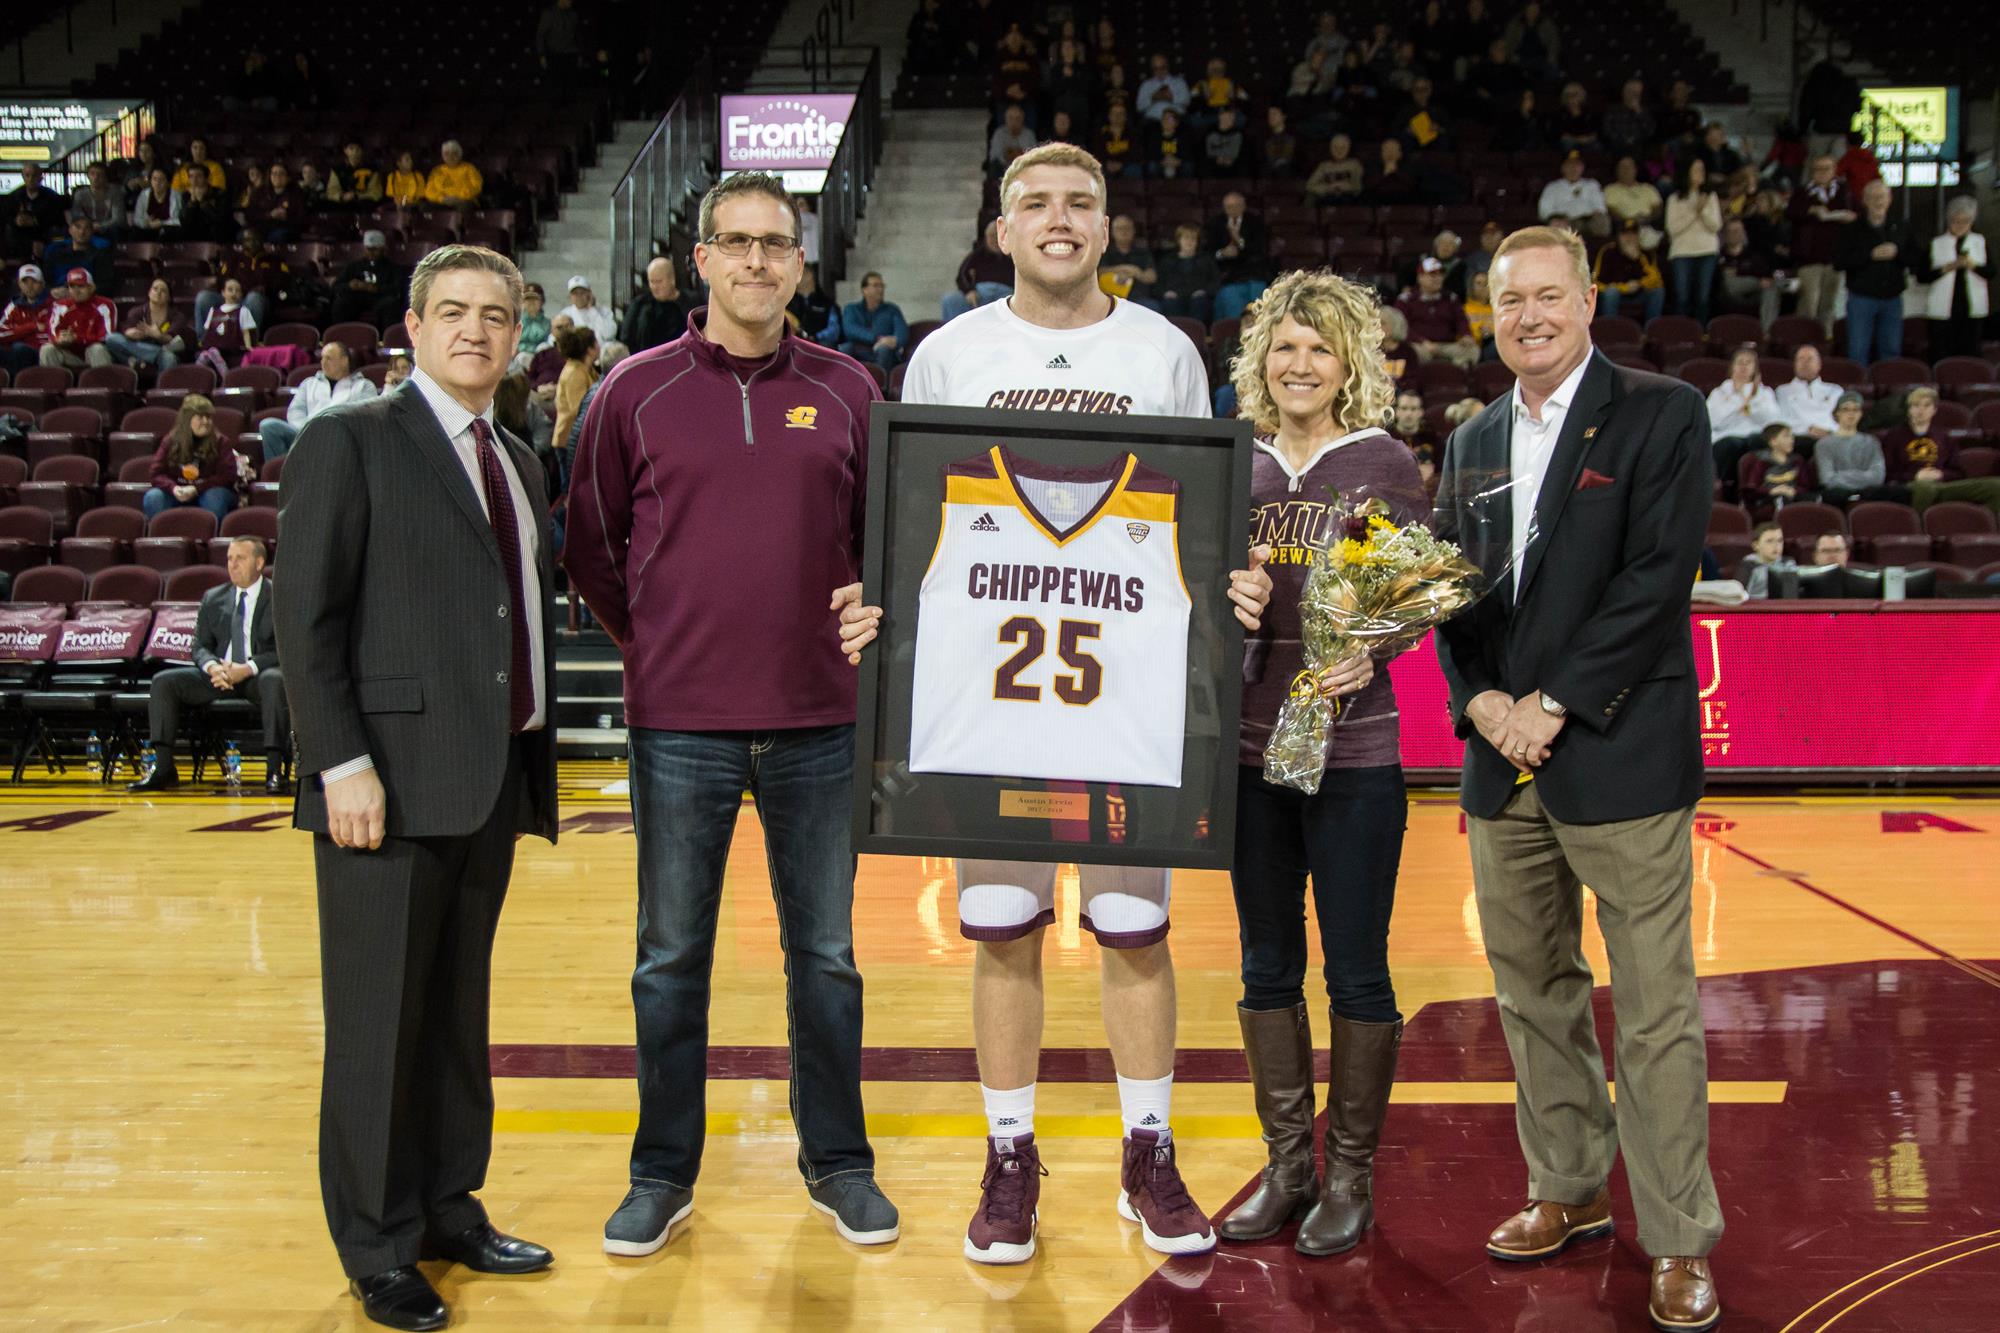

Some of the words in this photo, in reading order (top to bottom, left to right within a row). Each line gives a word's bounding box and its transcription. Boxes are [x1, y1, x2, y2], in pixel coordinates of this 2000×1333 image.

[10, 105, 29, 117] the
[30, 107, 64, 119] game,
[64, 105, 89, 119] skip
[1, 117, 22, 129] line
[23, 117, 49, 129] with
[49, 117, 93, 130] MOBILE
[728, 115, 845, 147] Frontie
[0, 129, 22, 141] DER
[33, 129, 56, 141] PAY
[728, 147, 837, 161] COMMUNICATIO
[985, 388, 1133, 416] CHIPPEWAS
[970, 522, 1000, 532] adidas
[1269, 547, 1326, 571] PEWAS
[968, 563, 1144, 613] CHIPPEWAS
[0, 630, 48, 646] ontier
[62, 629, 132, 647] Frontier
[152, 627, 194, 646] Fron
[60, 644, 125, 652] COMMUNICATIONS
[993, 615, 1103, 707] 25
[1018, 797, 1046, 805] Austin
